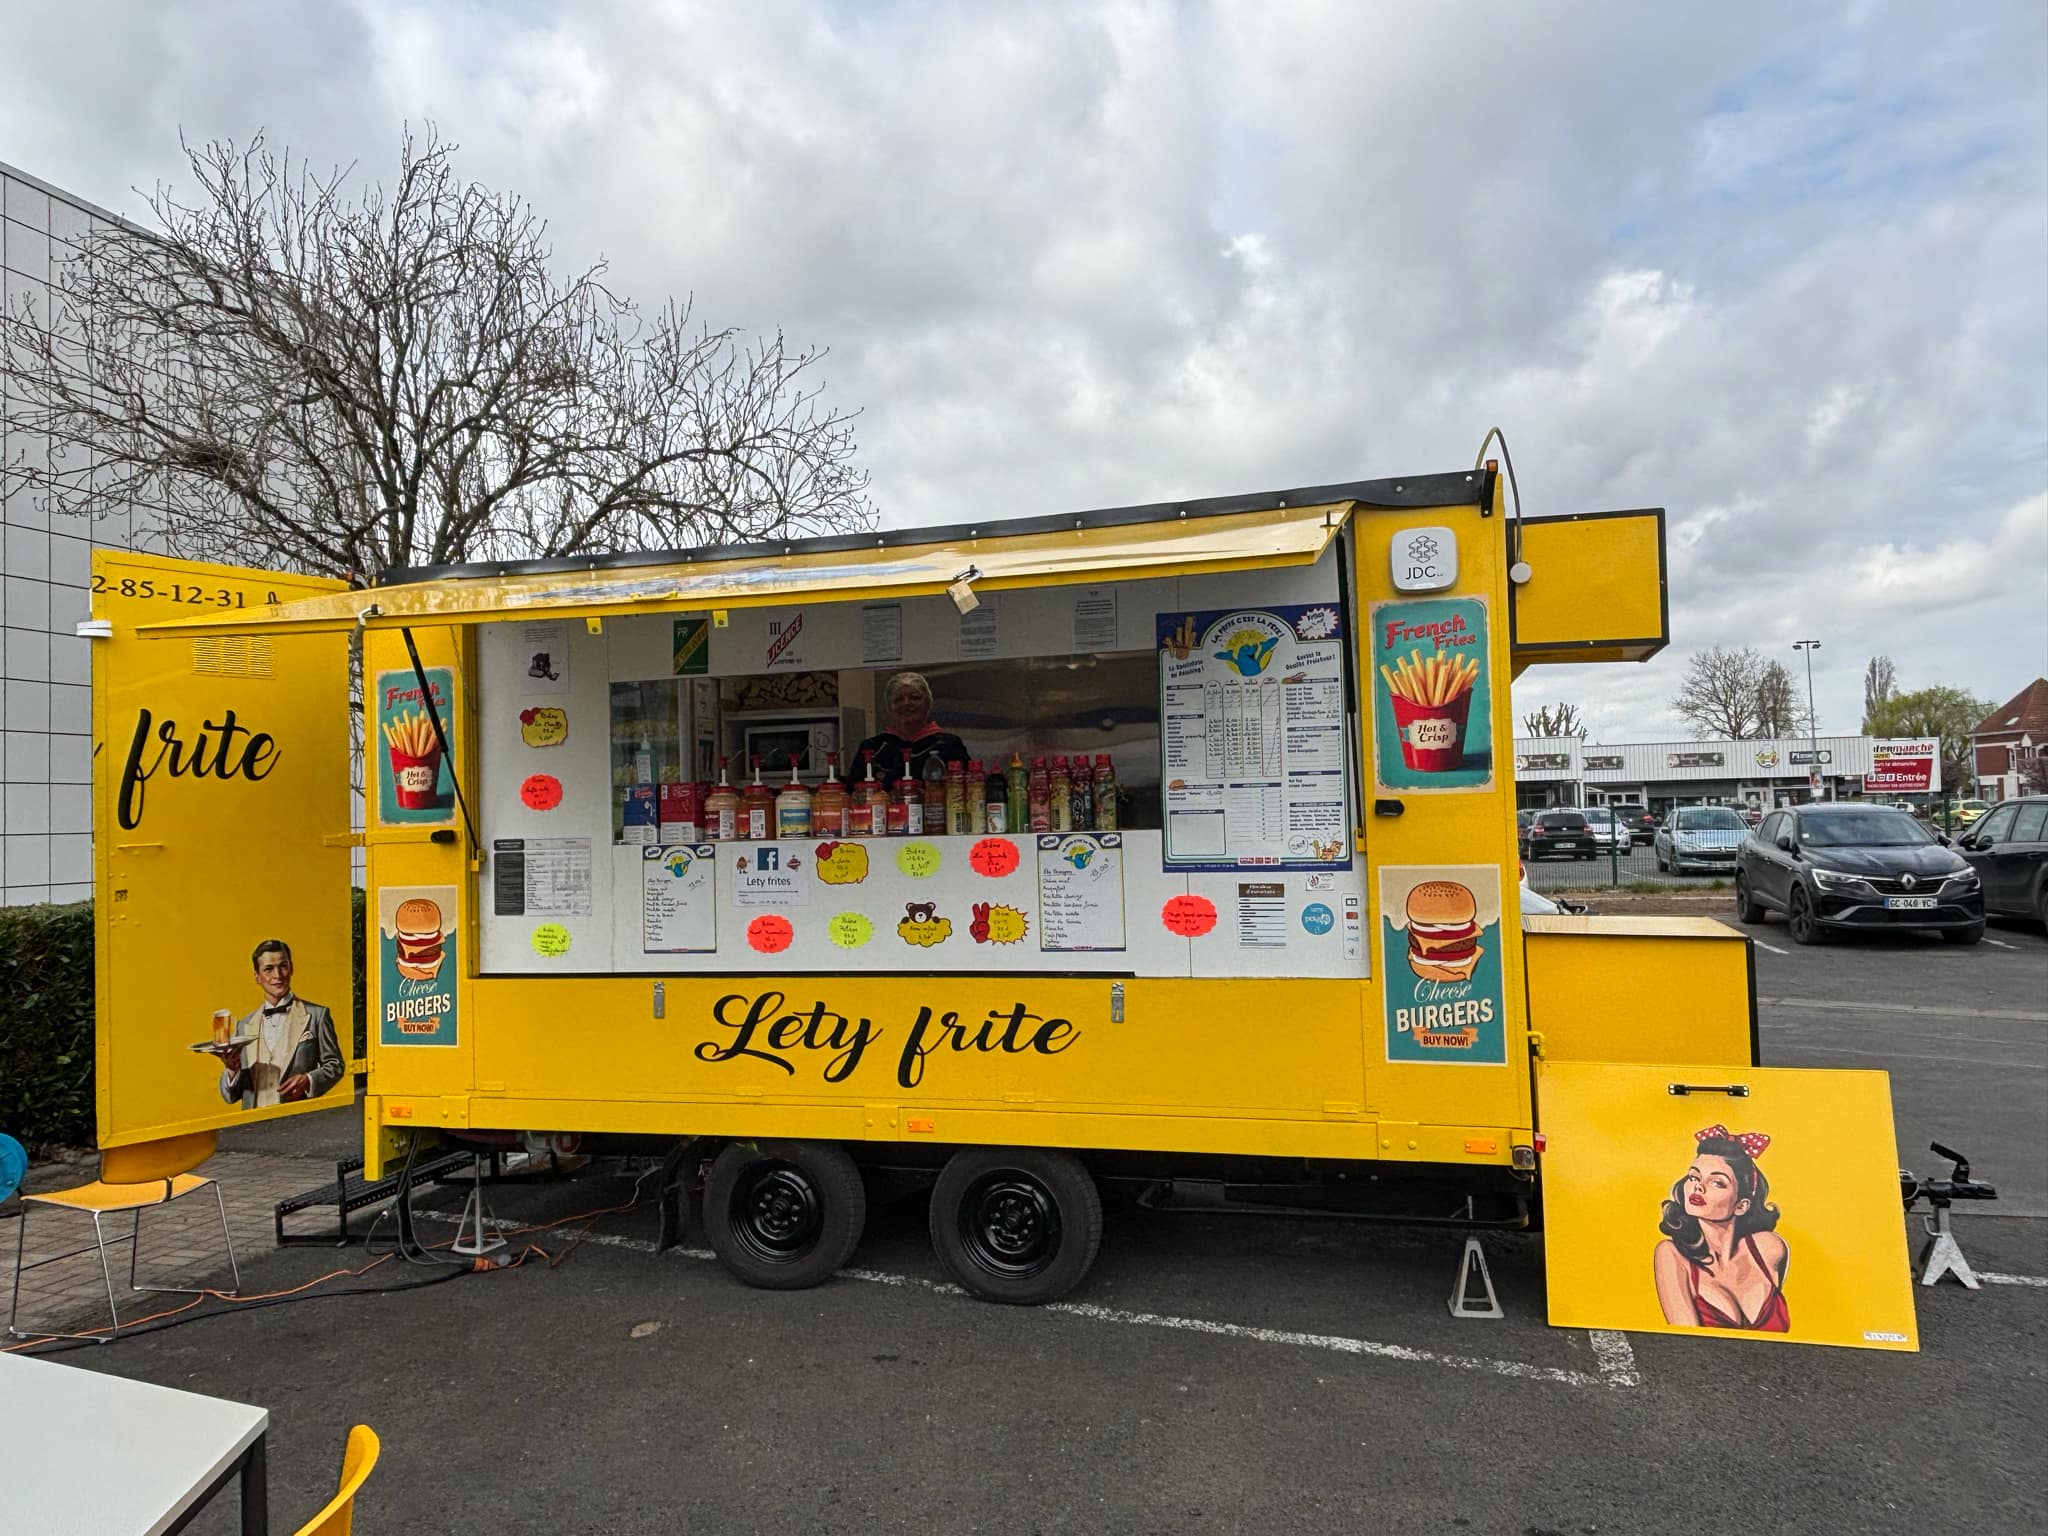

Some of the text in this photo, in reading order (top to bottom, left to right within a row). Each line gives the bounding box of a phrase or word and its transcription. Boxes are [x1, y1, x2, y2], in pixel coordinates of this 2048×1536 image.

[1405, 565, 1436, 580] JDC
[91, 575, 246, 609] 2-85-12-31
[769, 621, 782, 636] III
[1384, 613, 1467, 650] French
[767, 614, 803, 667] LICENCE
[1432, 633, 1477, 651] Fries
[1417, 723, 1447, 734] Hot &
[1418, 732, 1449, 745] Crisp
[1873, 743, 1934, 754] termarché
[118, 708, 281, 830] frite
[406, 770, 420, 779] Hot
[407, 777, 429, 787] Crisp
[1896, 772, 1927, 782] Entrée
[746, 875, 791, 889] Lety frites
[398, 978, 438, 999] Cheese
[1413, 978, 1473, 1004] Cheese
[386, 993, 452, 1023] BURGERS
[1395, 998, 1496, 1033] BURGERS
[403, 1023, 435, 1033] BUY NOW!
[694, 991, 1082, 1089] Lety frite
[1422, 1035, 1470, 1047] BUY NOW!
